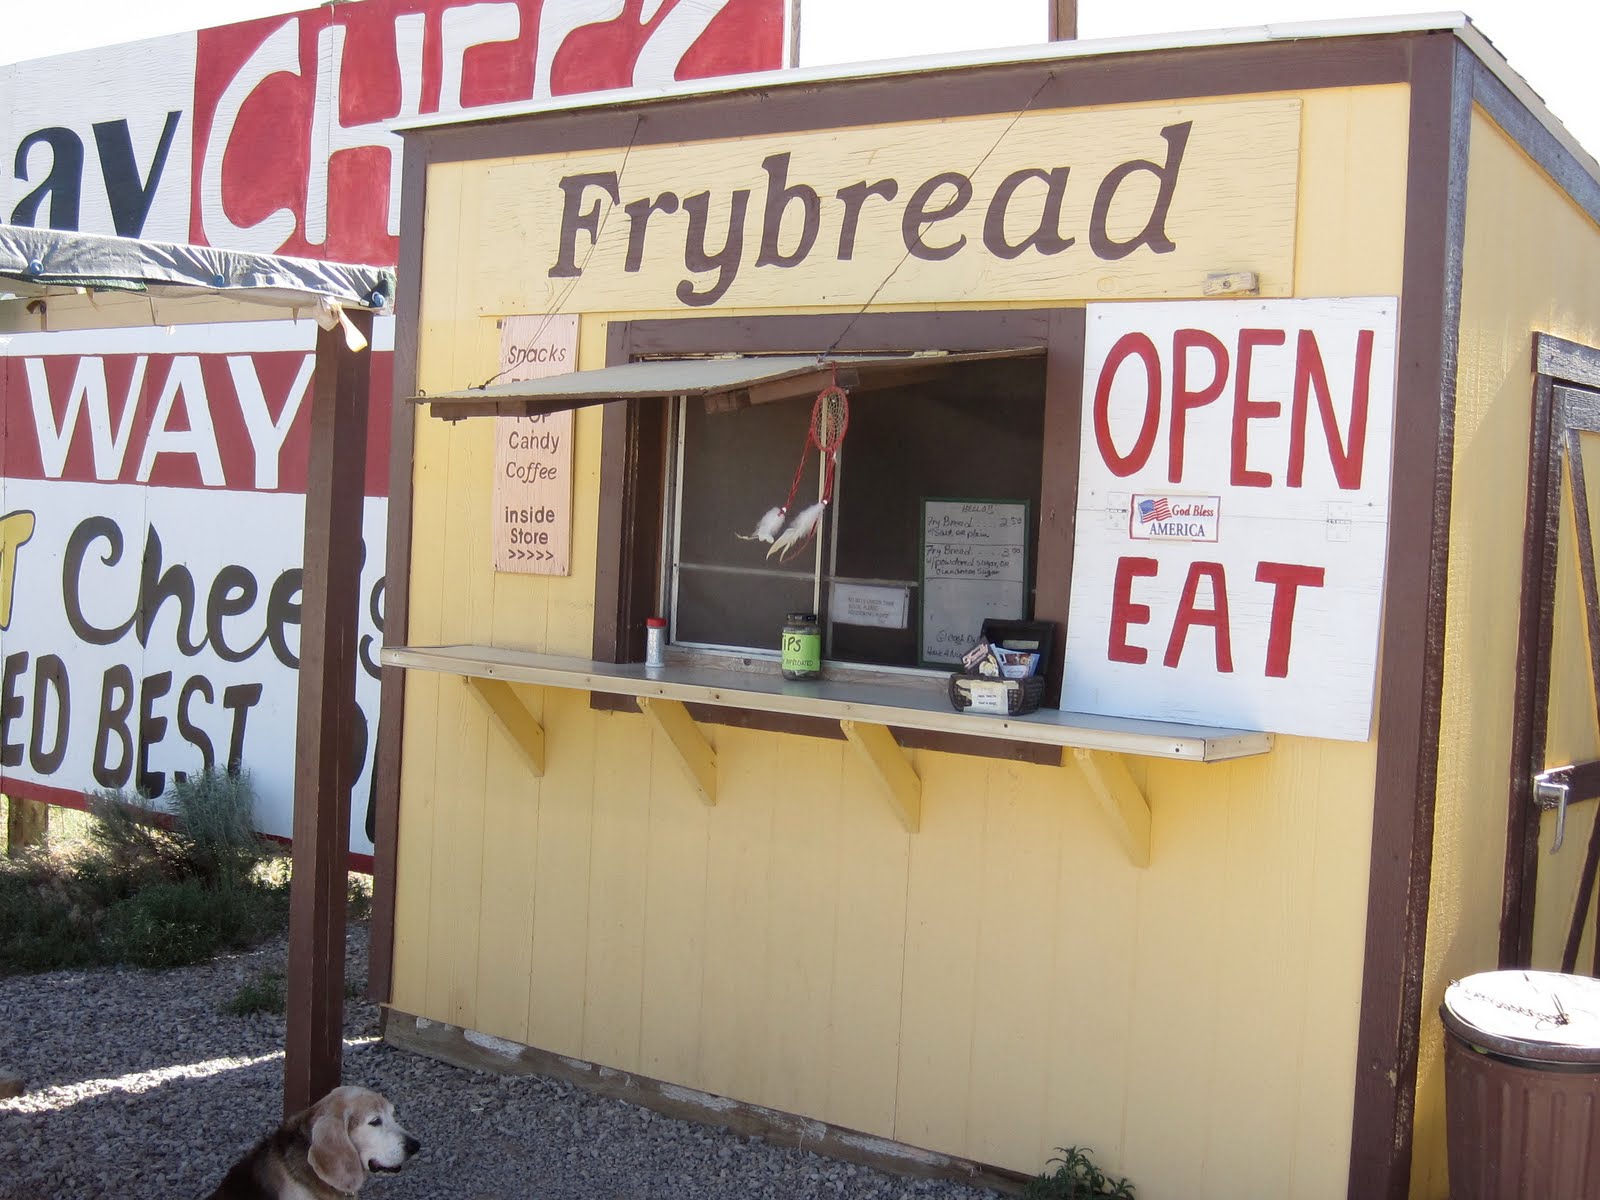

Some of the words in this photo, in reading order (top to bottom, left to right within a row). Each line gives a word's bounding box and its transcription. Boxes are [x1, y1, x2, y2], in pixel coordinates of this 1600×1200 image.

[547, 119, 1194, 307] Frybread
[508, 345, 567, 365] Snacks
[1093, 328, 1375, 490] OPEN
[24, 354, 316, 490] WAY
[508, 431, 561, 455] Candy
[505, 461, 558, 484] Coffee
[504, 506, 556, 524] inside
[1172, 504, 1191, 516] God
[1193, 505, 1214, 517] Bless
[510, 527, 549, 545] Store
[1149, 523, 1205, 537] AMERICA
[1107, 556, 1325, 678] EAT
[92, 663, 263, 799] BEST
